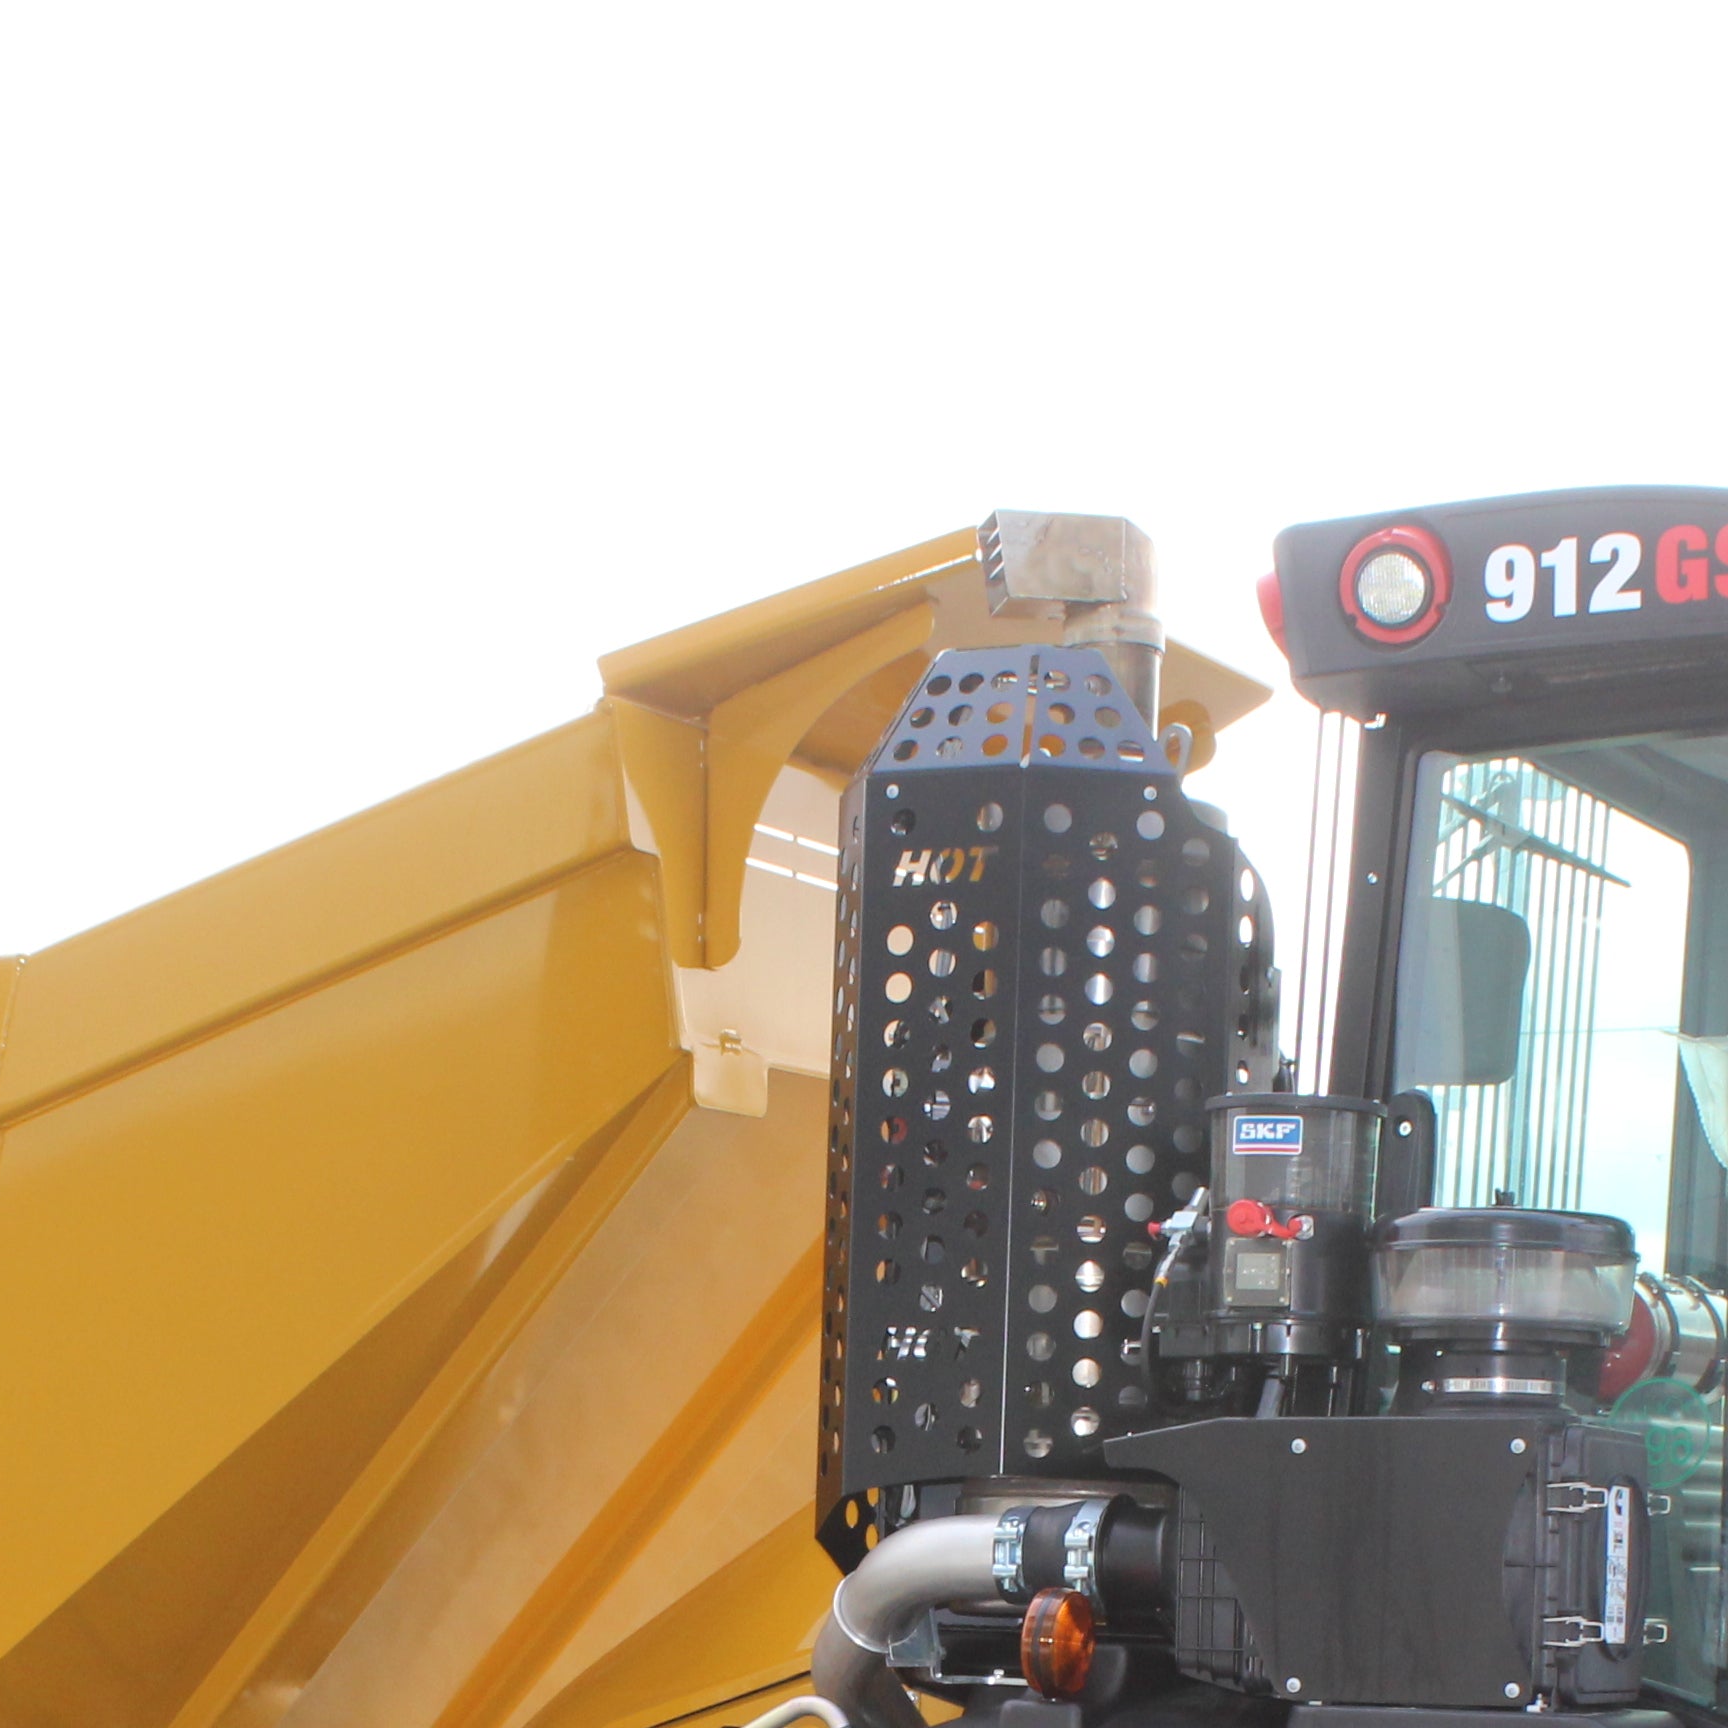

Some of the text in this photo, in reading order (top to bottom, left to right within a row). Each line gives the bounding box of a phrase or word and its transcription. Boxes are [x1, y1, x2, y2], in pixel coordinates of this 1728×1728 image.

[1484, 532, 1643, 623] 912
[892, 844, 999, 887] HOT
[1239, 1122, 1297, 1140] SKF
